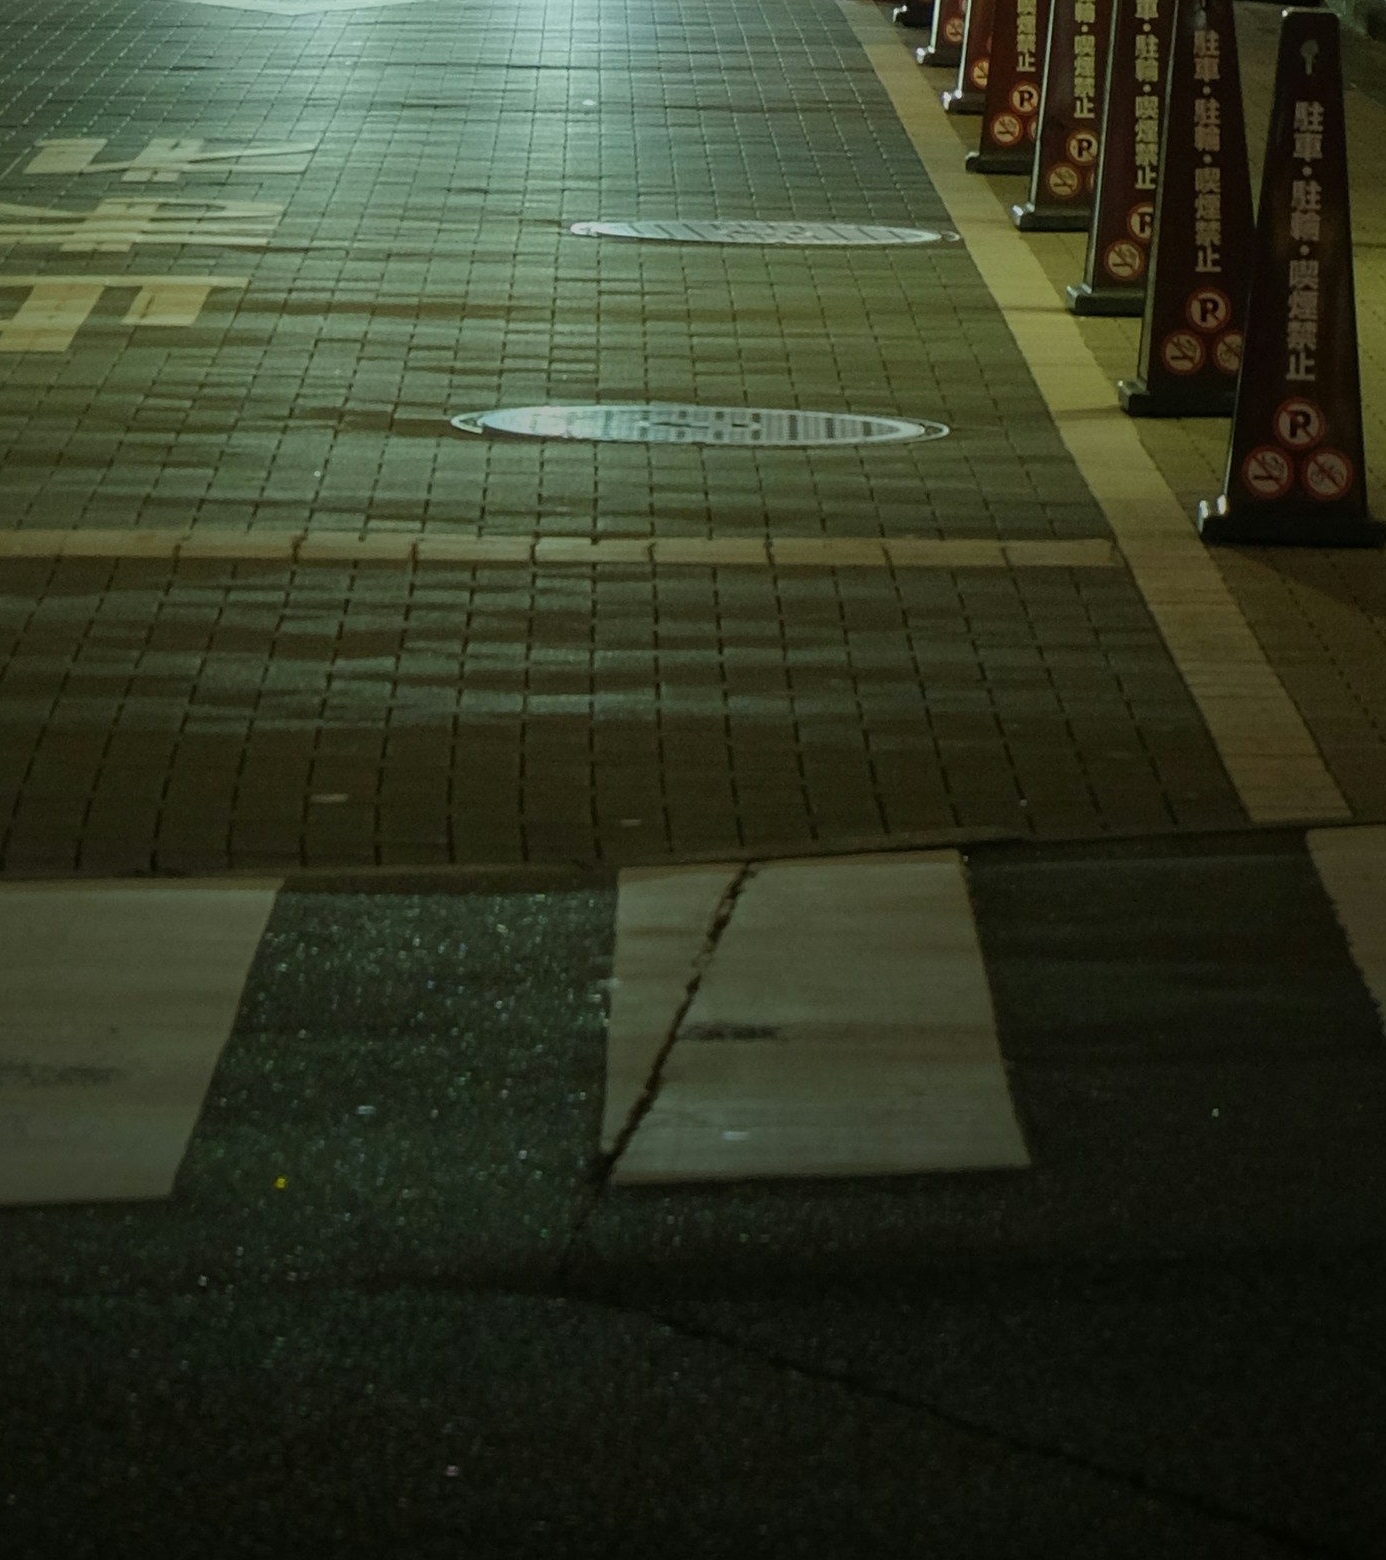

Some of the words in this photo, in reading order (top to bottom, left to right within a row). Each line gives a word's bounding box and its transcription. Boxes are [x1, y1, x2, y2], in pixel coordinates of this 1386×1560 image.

[1191, 29, 1223, 275] 駐車・駐輪・喫煙禁止
[1285, 100, 1324, 382] 駐車・駐輪・喫煙禁止
